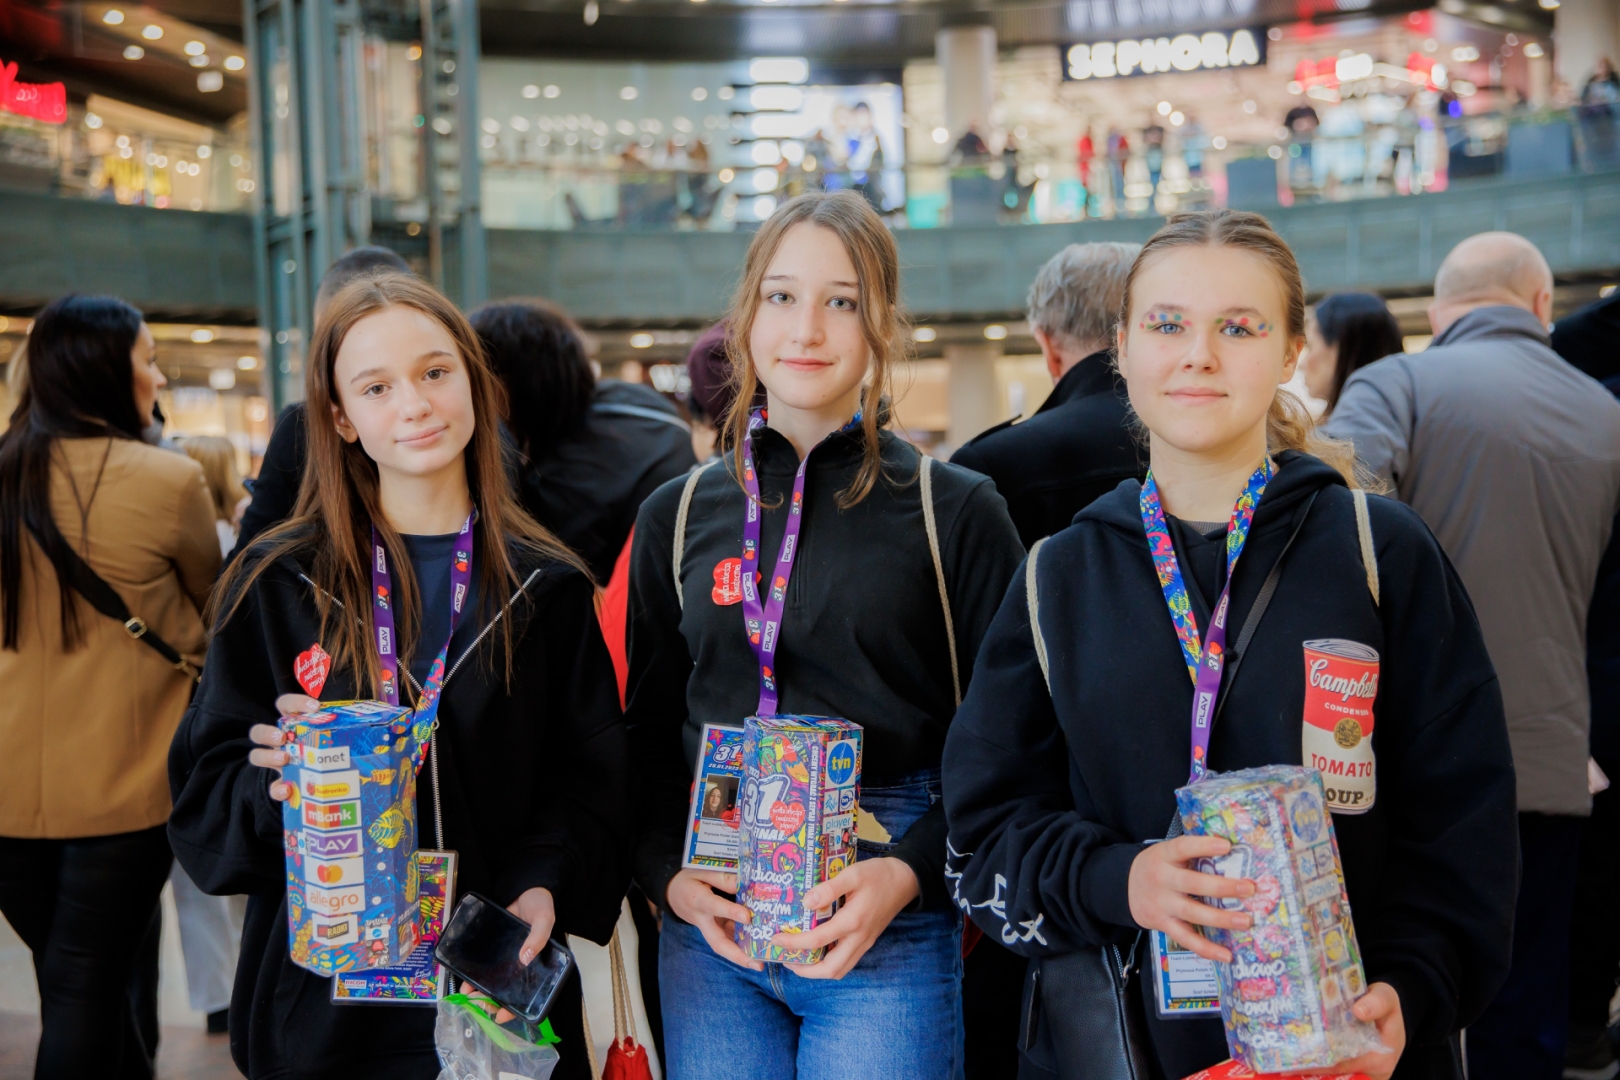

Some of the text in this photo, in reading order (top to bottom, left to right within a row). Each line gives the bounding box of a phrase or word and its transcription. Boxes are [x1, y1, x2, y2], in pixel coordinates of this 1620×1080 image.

[1067, 29, 1260, 80] SEPHORA
[377, 547, 386, 573] PLAY
[784, 537, 794, 562] PLAY
[744, 574, 754, 599] PLAY
[773, 586, 784, 601] 31
[377, 593, 389, 610] 31
[455, 585, 465, 611] PLAY
[1216, 597, 1227, 627] PLAY
[748, 620, 760, 633] 31
[764, 624, 775, 650] PLAY
[381, 629, 389, 653] PLAY
[1208, 652, 1220, 671] 31
[763, 675, 775, 691] 31
[1198, 696, 1208, 725] PLAY
[317, 752, 346, 764] onet
[832, 756, 851, 770] tvn
[1311, 753, 1372, 778] TOMATO
[743, 778, 786, 825] 31
[1325, 787, 1364, 805] OUP
[308, 809, 352, 823] mBank
[825, 816, 851, 832] player
[310, 837, 353, 853] PLAY
[805, 851, 814, 889] WSZYSTKICH
[309, 890, 359, 912] allegro
[1307, 882, 1336, 902] player
